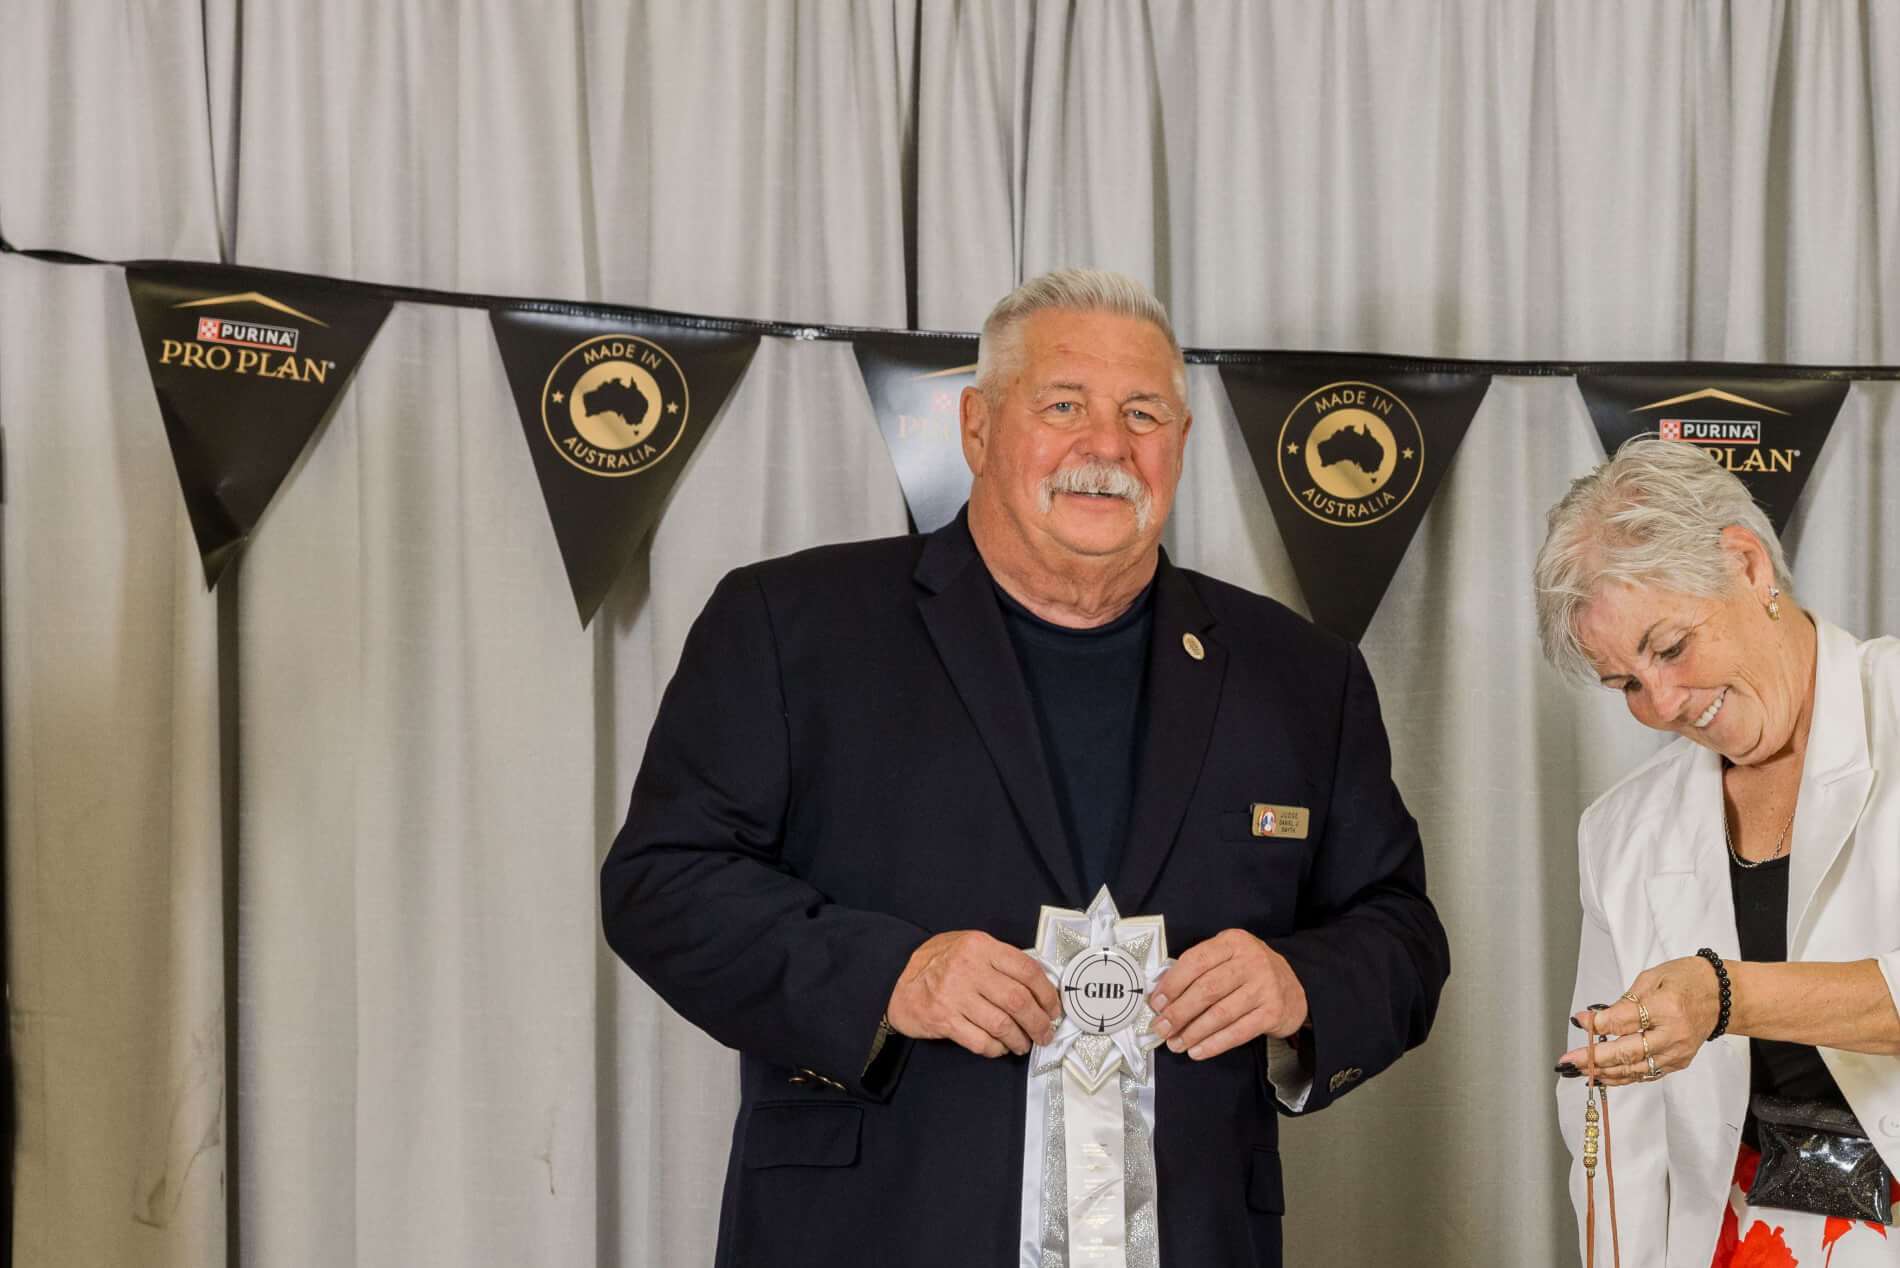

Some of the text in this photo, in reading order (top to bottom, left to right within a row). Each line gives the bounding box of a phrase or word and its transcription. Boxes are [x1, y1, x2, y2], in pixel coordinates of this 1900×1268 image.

[221, 323, 294, 347] PURINA
[159, 339, 232, 371] PRO
[584, 342, 662, 369] MADE IN
[1314, 390, 1393, 415] MADE IN
[1682, 423, 1757, 439] PURINA
[562, 436, 656, 468] AUSTRALIA
[1302, 488, 1396, 518] AUSTRALIA
[1083, 982, 1125, 1000] GHB
